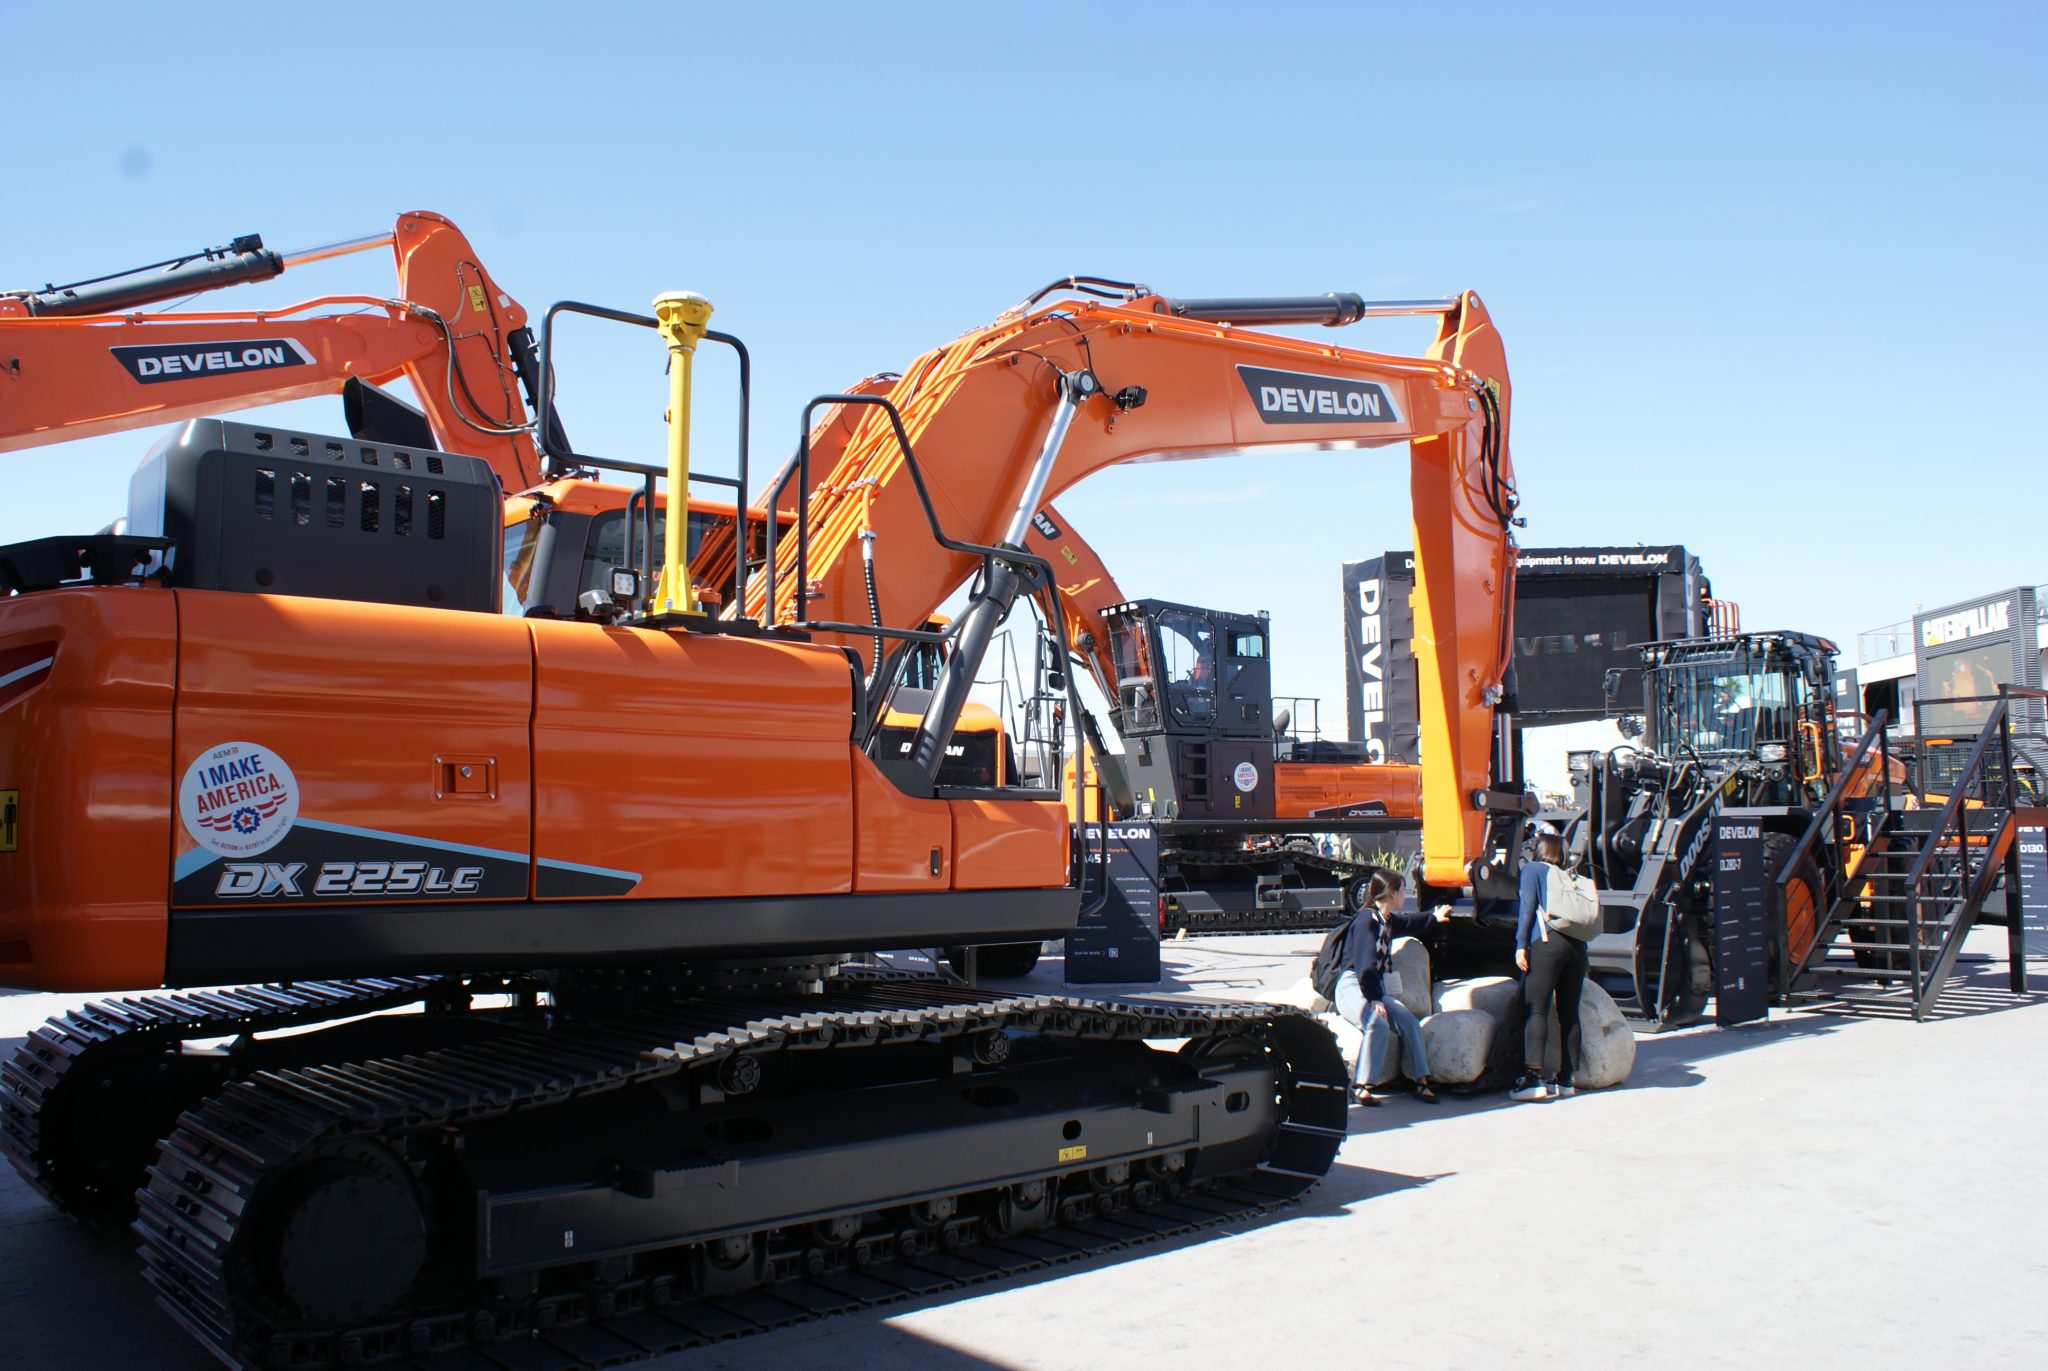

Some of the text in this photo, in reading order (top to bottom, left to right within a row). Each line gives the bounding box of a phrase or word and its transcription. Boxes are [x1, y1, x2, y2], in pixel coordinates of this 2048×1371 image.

[137, 346, 285, 376] DEVELON
[1261, 386, 1381, 417] DEVELON
[1564, 555, 1573, 566] is
[1575, 557, 1596, 566] now
[1598, 554, 1668, 565] DEVELON
[198, 754, 264, 789] I MAKE
[197, 772, 281, 814] AMERICA
[1720, 826, 1760, 839] DEVELON
[215, 862, 308, 898] DX
